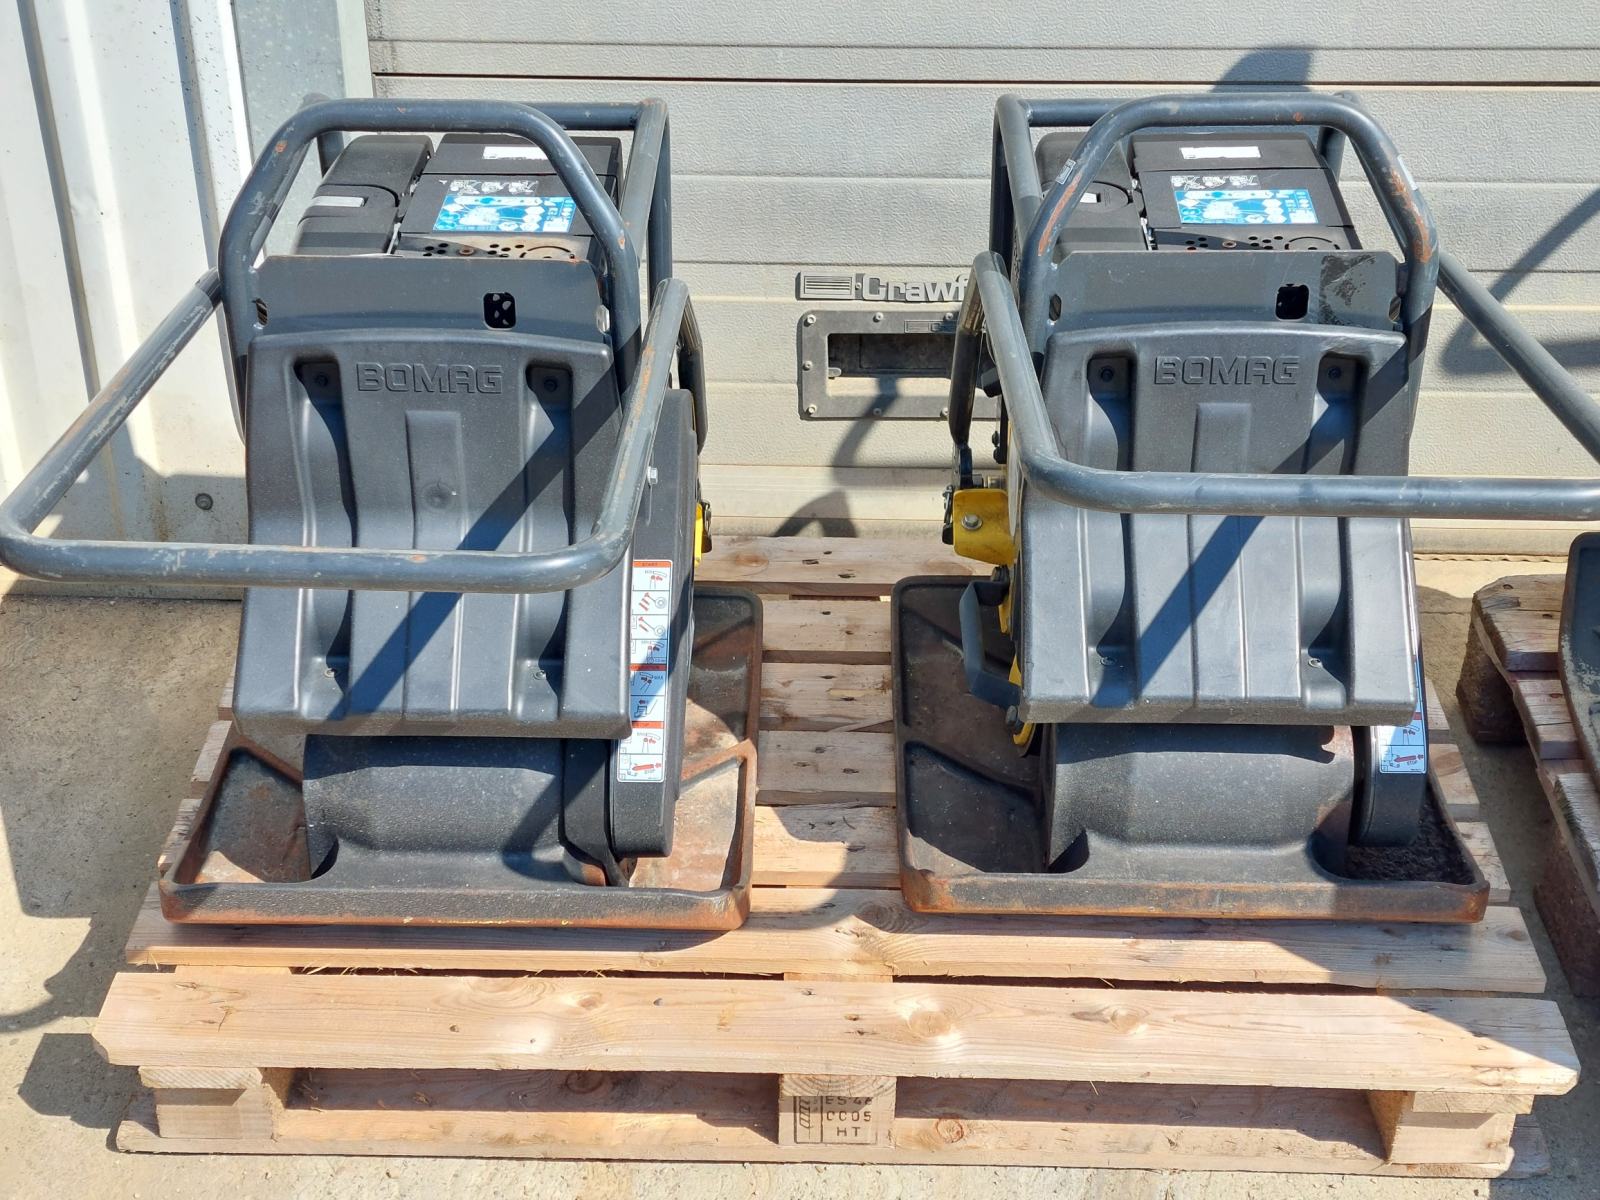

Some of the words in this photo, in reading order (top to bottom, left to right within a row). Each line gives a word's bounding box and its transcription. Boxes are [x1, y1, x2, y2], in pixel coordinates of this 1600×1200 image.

[357, 363, 503, 393] BOMAG
[1154, 357, 1299, 385] BOMAG
[837, 1127, 861, 1137] HT
